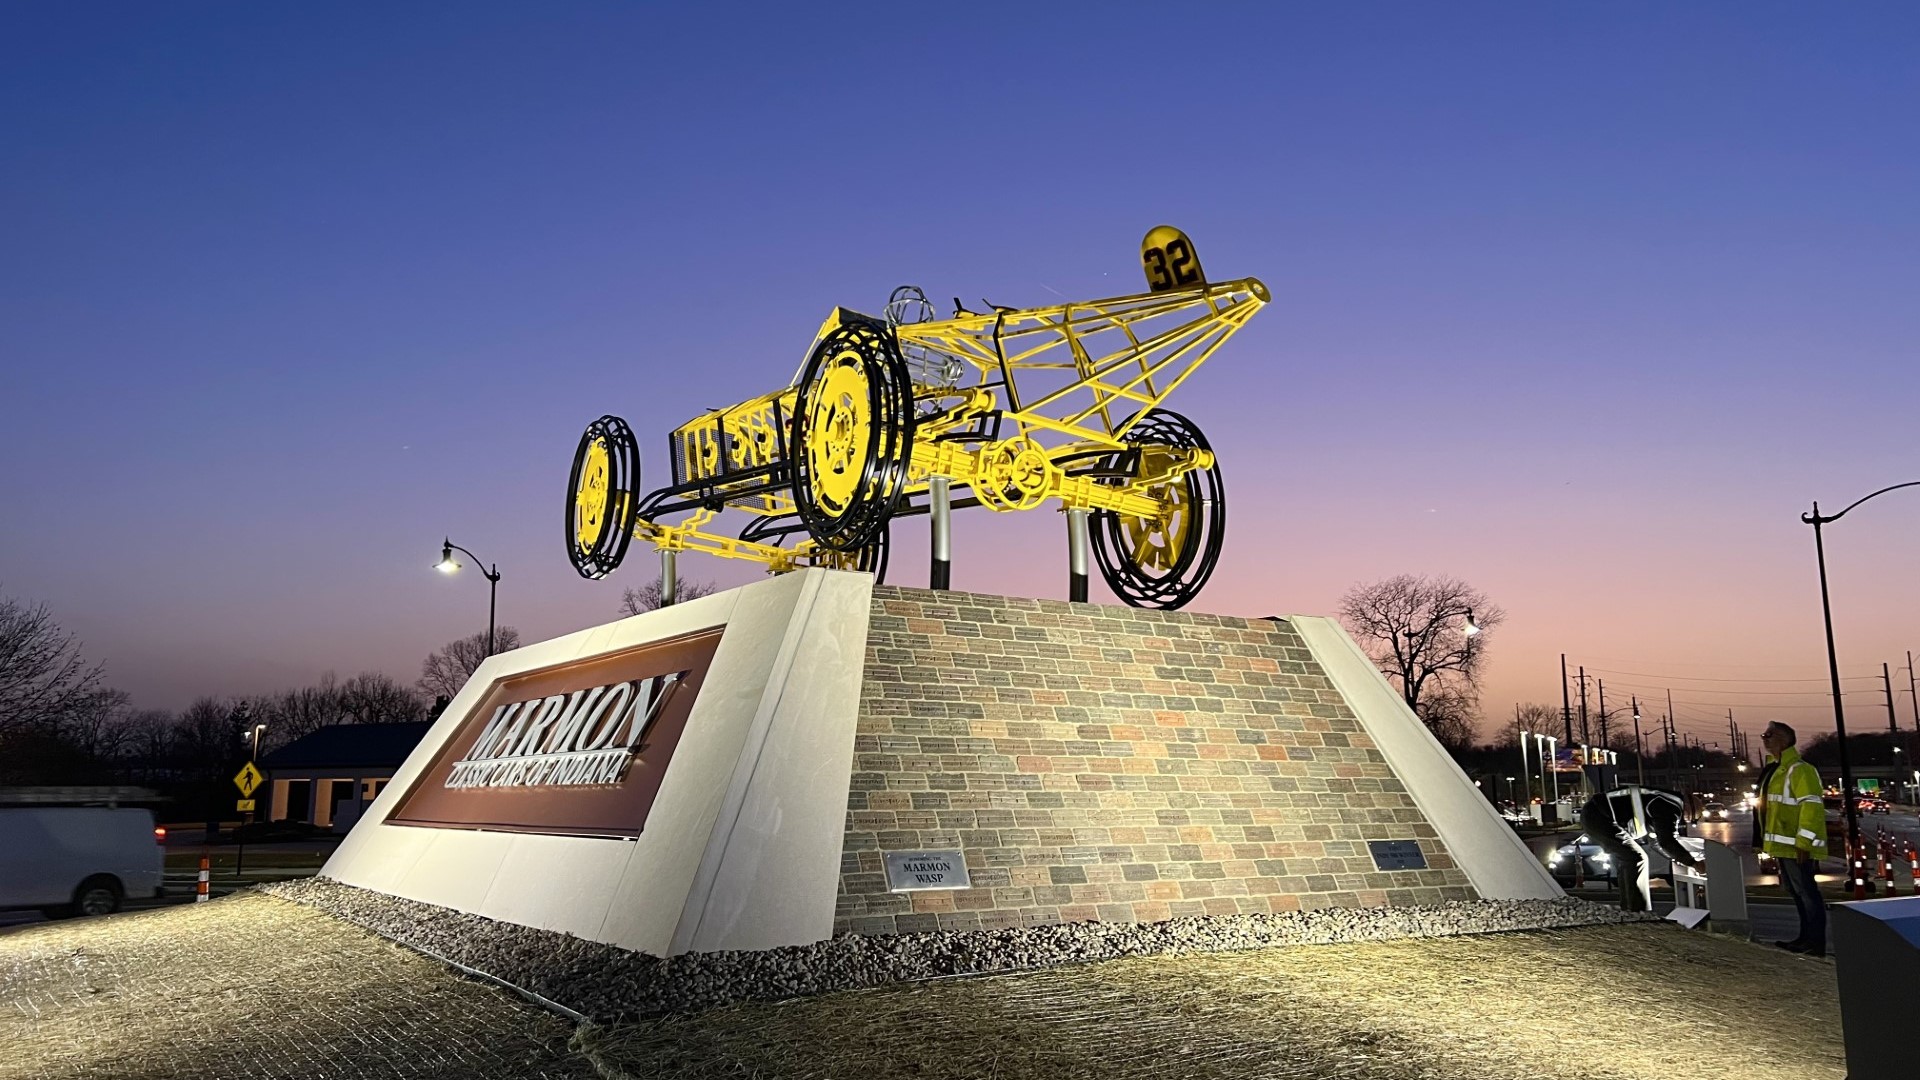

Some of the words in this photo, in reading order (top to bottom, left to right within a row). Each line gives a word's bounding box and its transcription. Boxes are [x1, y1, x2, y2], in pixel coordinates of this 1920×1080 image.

[1143, 239, 1200, 291] 32
[462, 672, 681, 761] MARMON
[444, 763, 502, 788] CLASSIC
[489, 760, 532, 787] CARS
[525, 757, 562, 786] OF
[545, 752, 628, 785] INDIANA
[903, 862, 951, 872] MARMON
[915, 873, 944, 883] WASP
